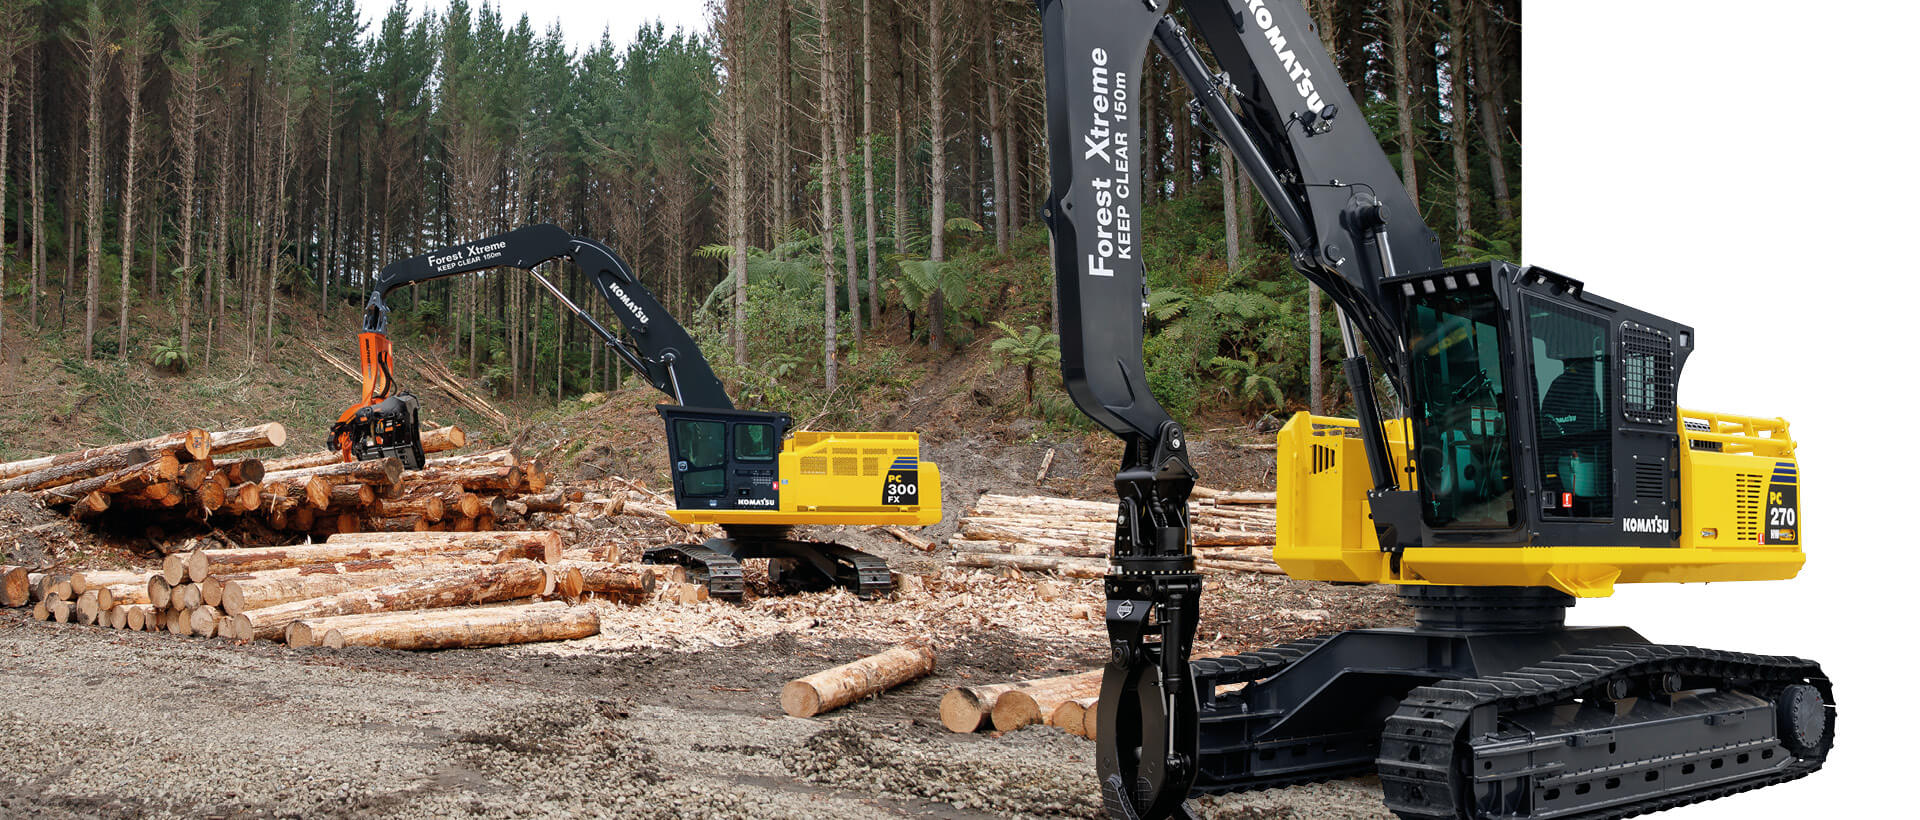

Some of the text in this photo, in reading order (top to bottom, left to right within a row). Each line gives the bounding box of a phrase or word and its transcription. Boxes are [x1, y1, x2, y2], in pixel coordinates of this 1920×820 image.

[1085, 48, 1114, 277] Forest Xtreme
[1113, 71, 1132, 259] KEEP CLEAR 150m
[428, 241, 506, 267] Forest Xtreme
[437, 251, 502, 273] KEEP CLEAR 150m
[609, 282, 649, 324] KOMATSU
[888, 474, 902, 483] PC
[887, 483, 917, 495] 300
[1769, 491, 1783, 505] PC
[737, 497, 775, 506] KOMATSU
[887, 495, 900, 503] FX
[1623, 514, 1669, 533] KOMATSU
[1770, 507, 1796, 527] 270
